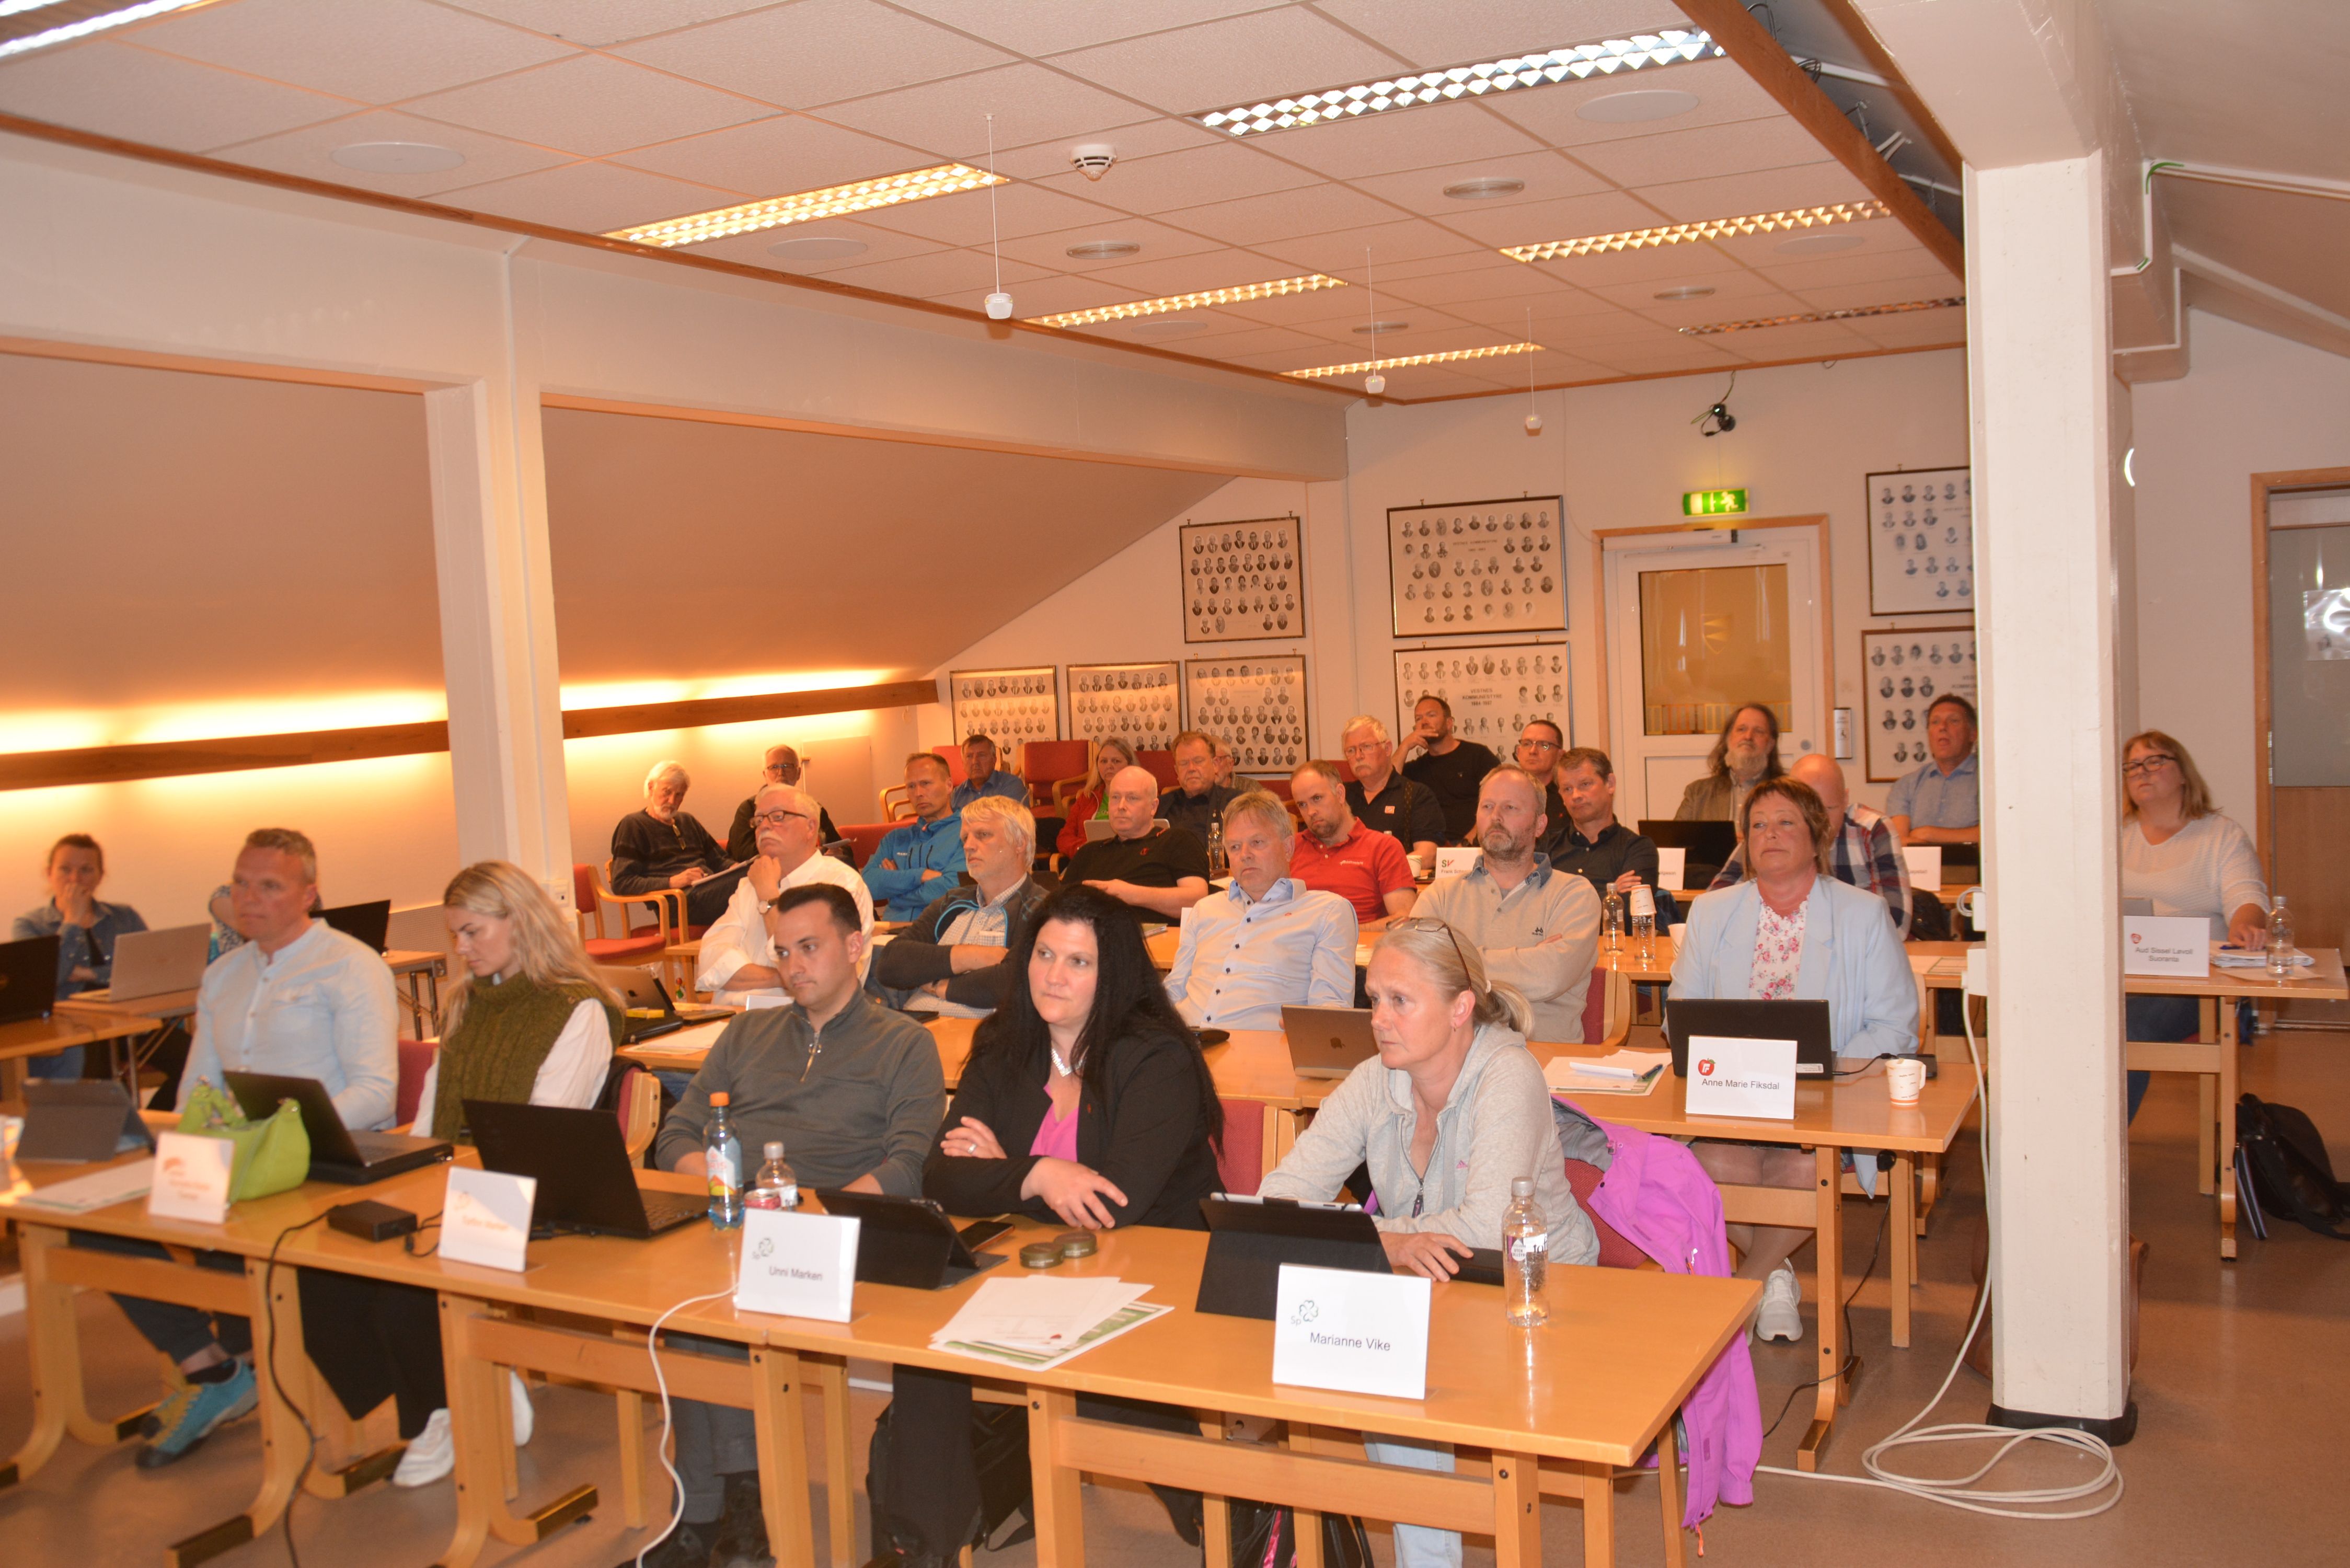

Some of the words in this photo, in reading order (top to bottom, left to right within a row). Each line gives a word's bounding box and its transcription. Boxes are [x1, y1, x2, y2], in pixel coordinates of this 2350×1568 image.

[1701, 1078, 1723, 1087] Anne
[1725, 1079, 1748, 1088] Marie
[1750, 1080, 1780, 1090] Fiksdal
[768, 1265, 788, 1277] Unni
[791, 1268, 823, 1281] Marken
[1309, 1332, 1362, 1348] Marianne
[1366, 1338, 1391, 1352] Vike
